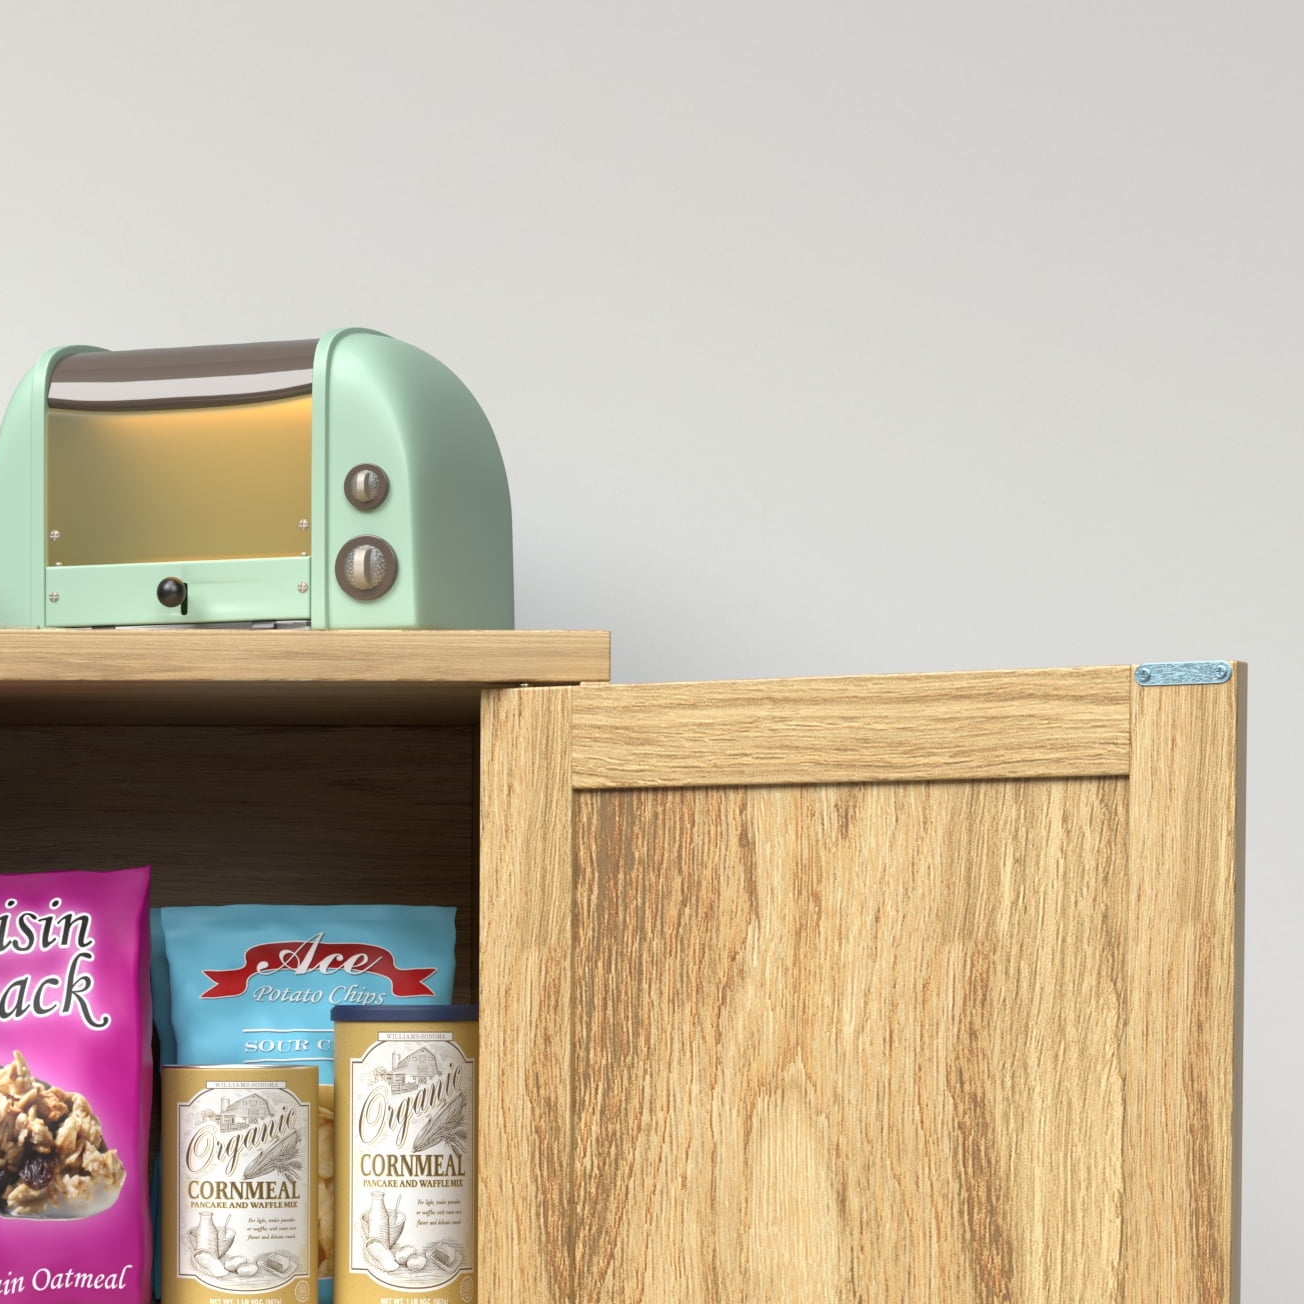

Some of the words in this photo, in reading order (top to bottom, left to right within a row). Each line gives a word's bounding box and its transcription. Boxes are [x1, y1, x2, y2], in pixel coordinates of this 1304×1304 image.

[256, 931, 383, 975] Ace
[253, 985, 324, 1004] Potato
[329, 984, 386, 1006] Chips
[244, 1039, 309, 1054] SOUR
[359, 1062, 463, 1149] Organic
[186, 1106, 296, 1177] Organic
[360, 1153, 466, 1177] CORNMEAL
[188, 1180, 300, 1200] CORNMEAL
[363, 1180, 398, 1188] PANCAKE
[399, 1180, 419, 1188] AND
[419, 1180, 450, 1188] WAFFLE
[451, 1179, 464, 1188] MIX
[31, 1264, 133, 1291] Oatmeal
